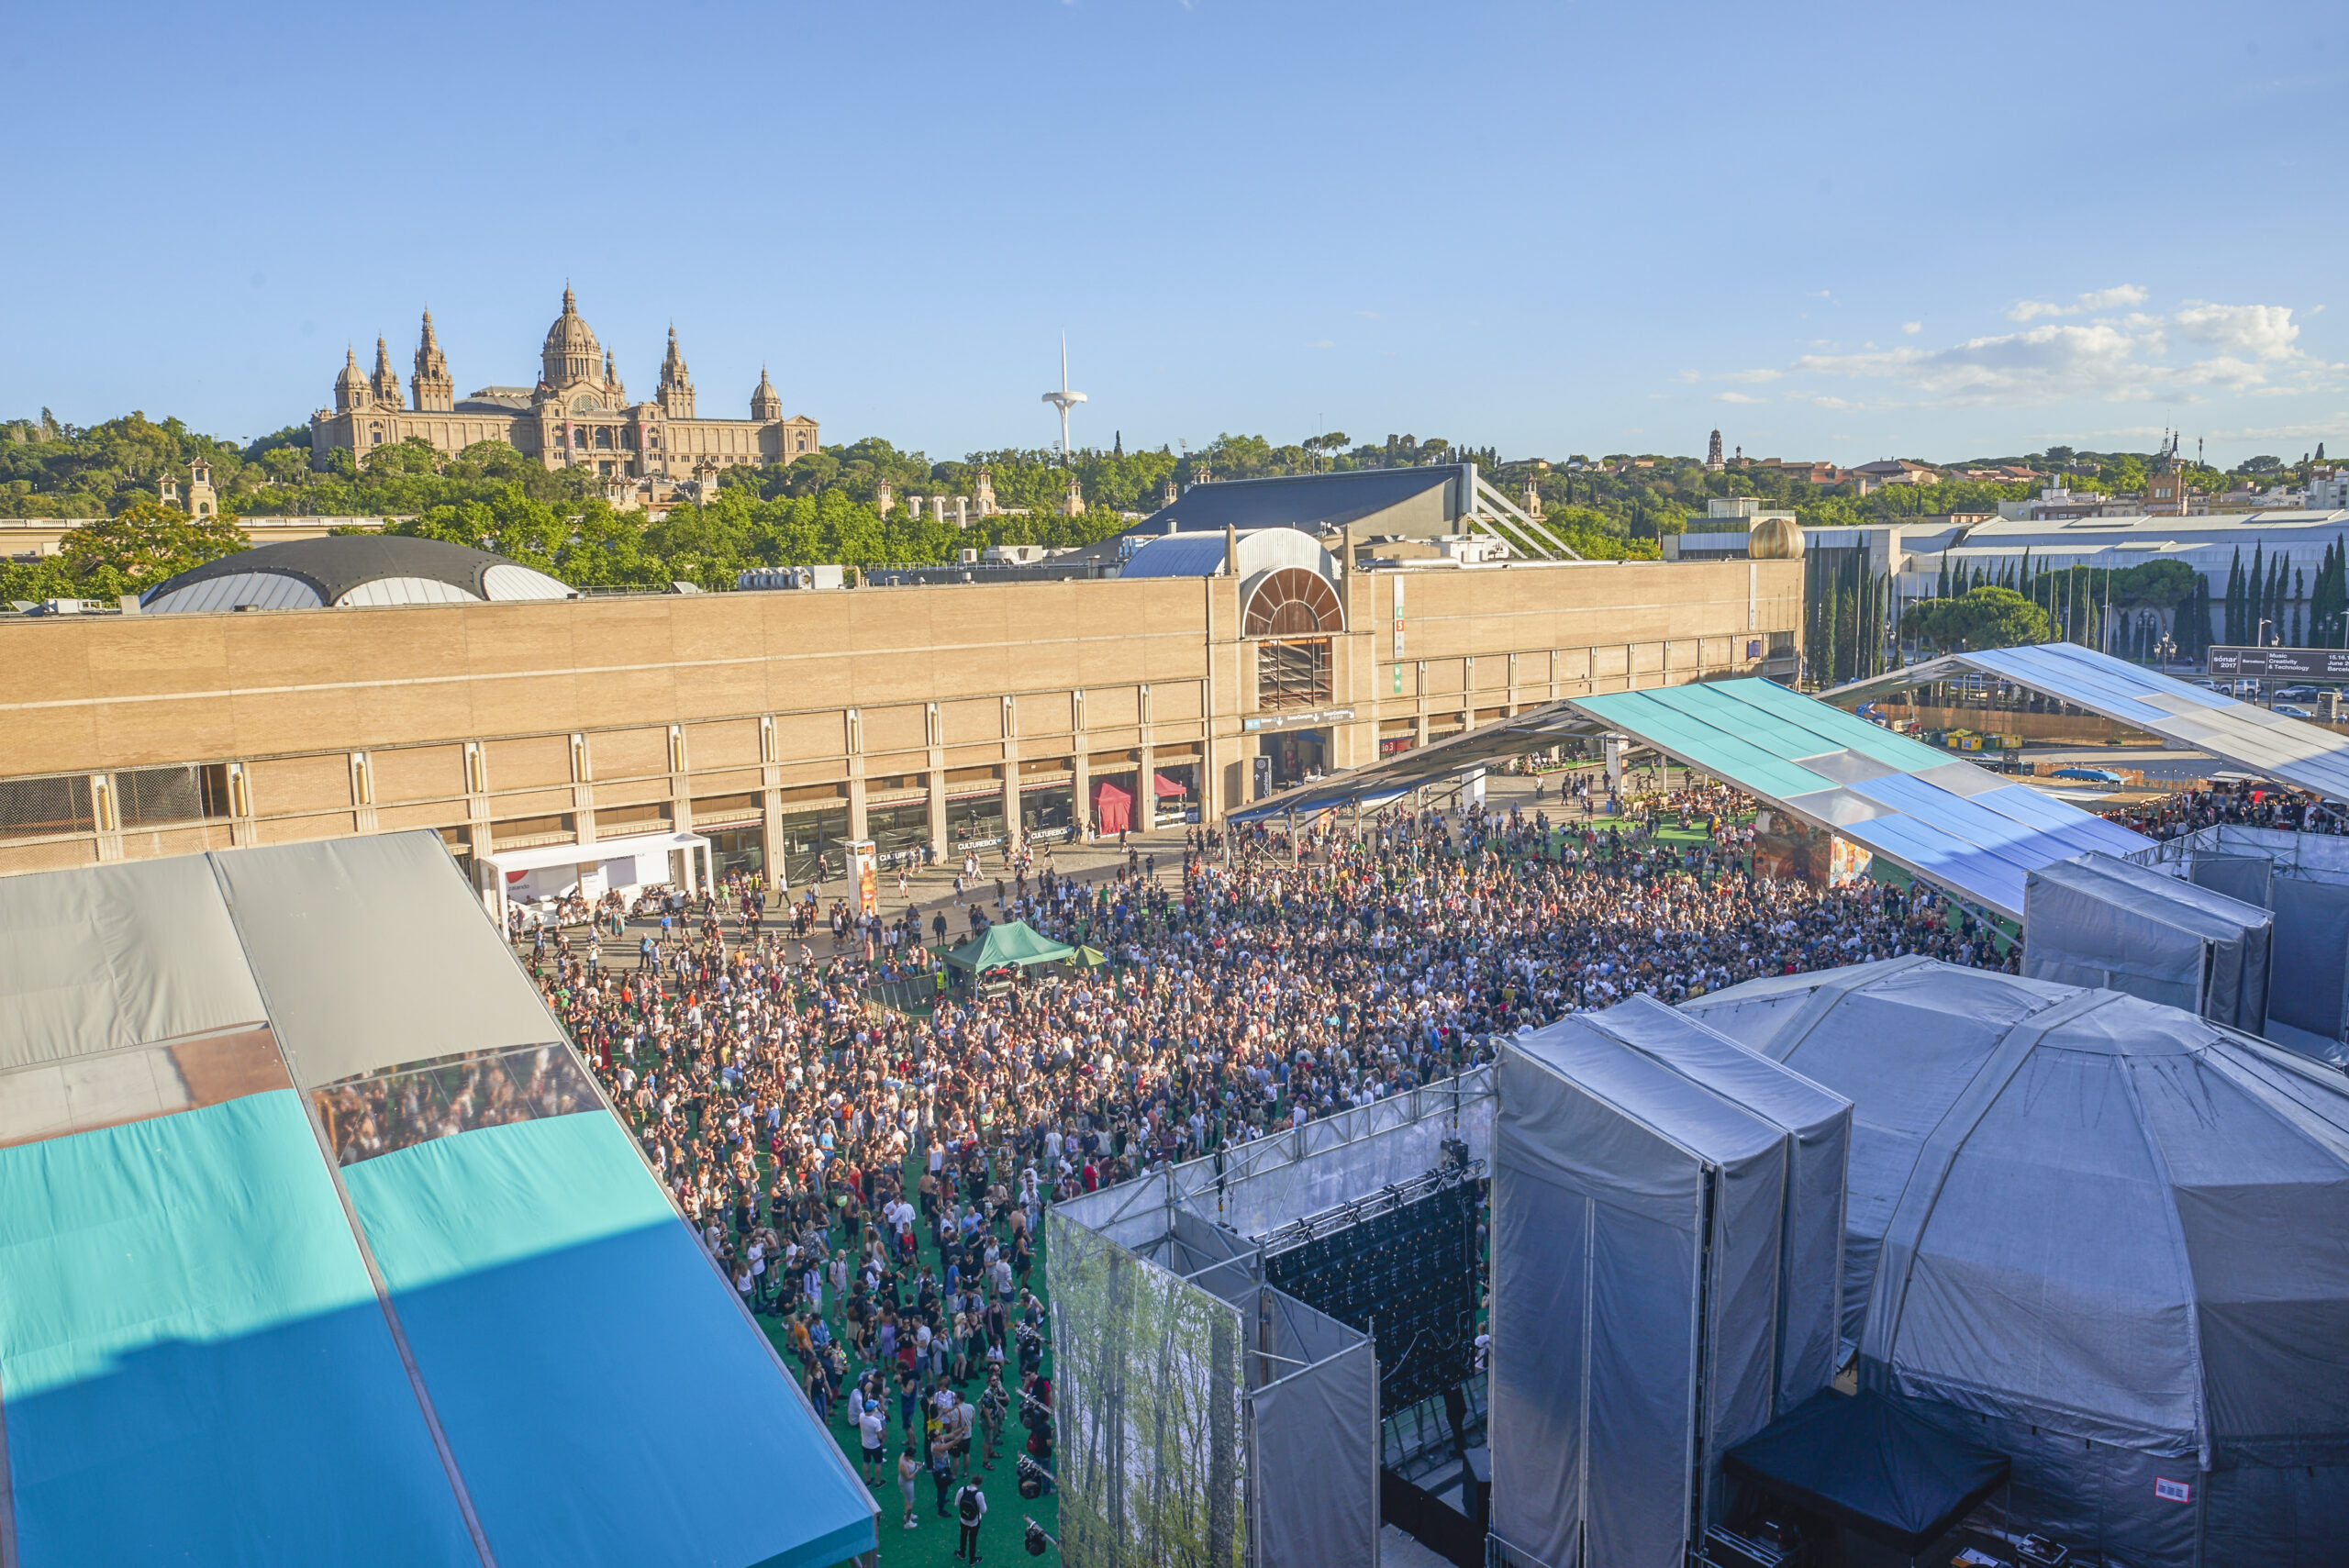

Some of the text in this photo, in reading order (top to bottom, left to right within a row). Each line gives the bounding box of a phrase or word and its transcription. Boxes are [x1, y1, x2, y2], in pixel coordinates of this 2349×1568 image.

[1030, 827, 1068, 840] CULTUREBOX
[958, 839, 997, 851] CULTUREBOX
[507, 884, 529, 892] zalando
